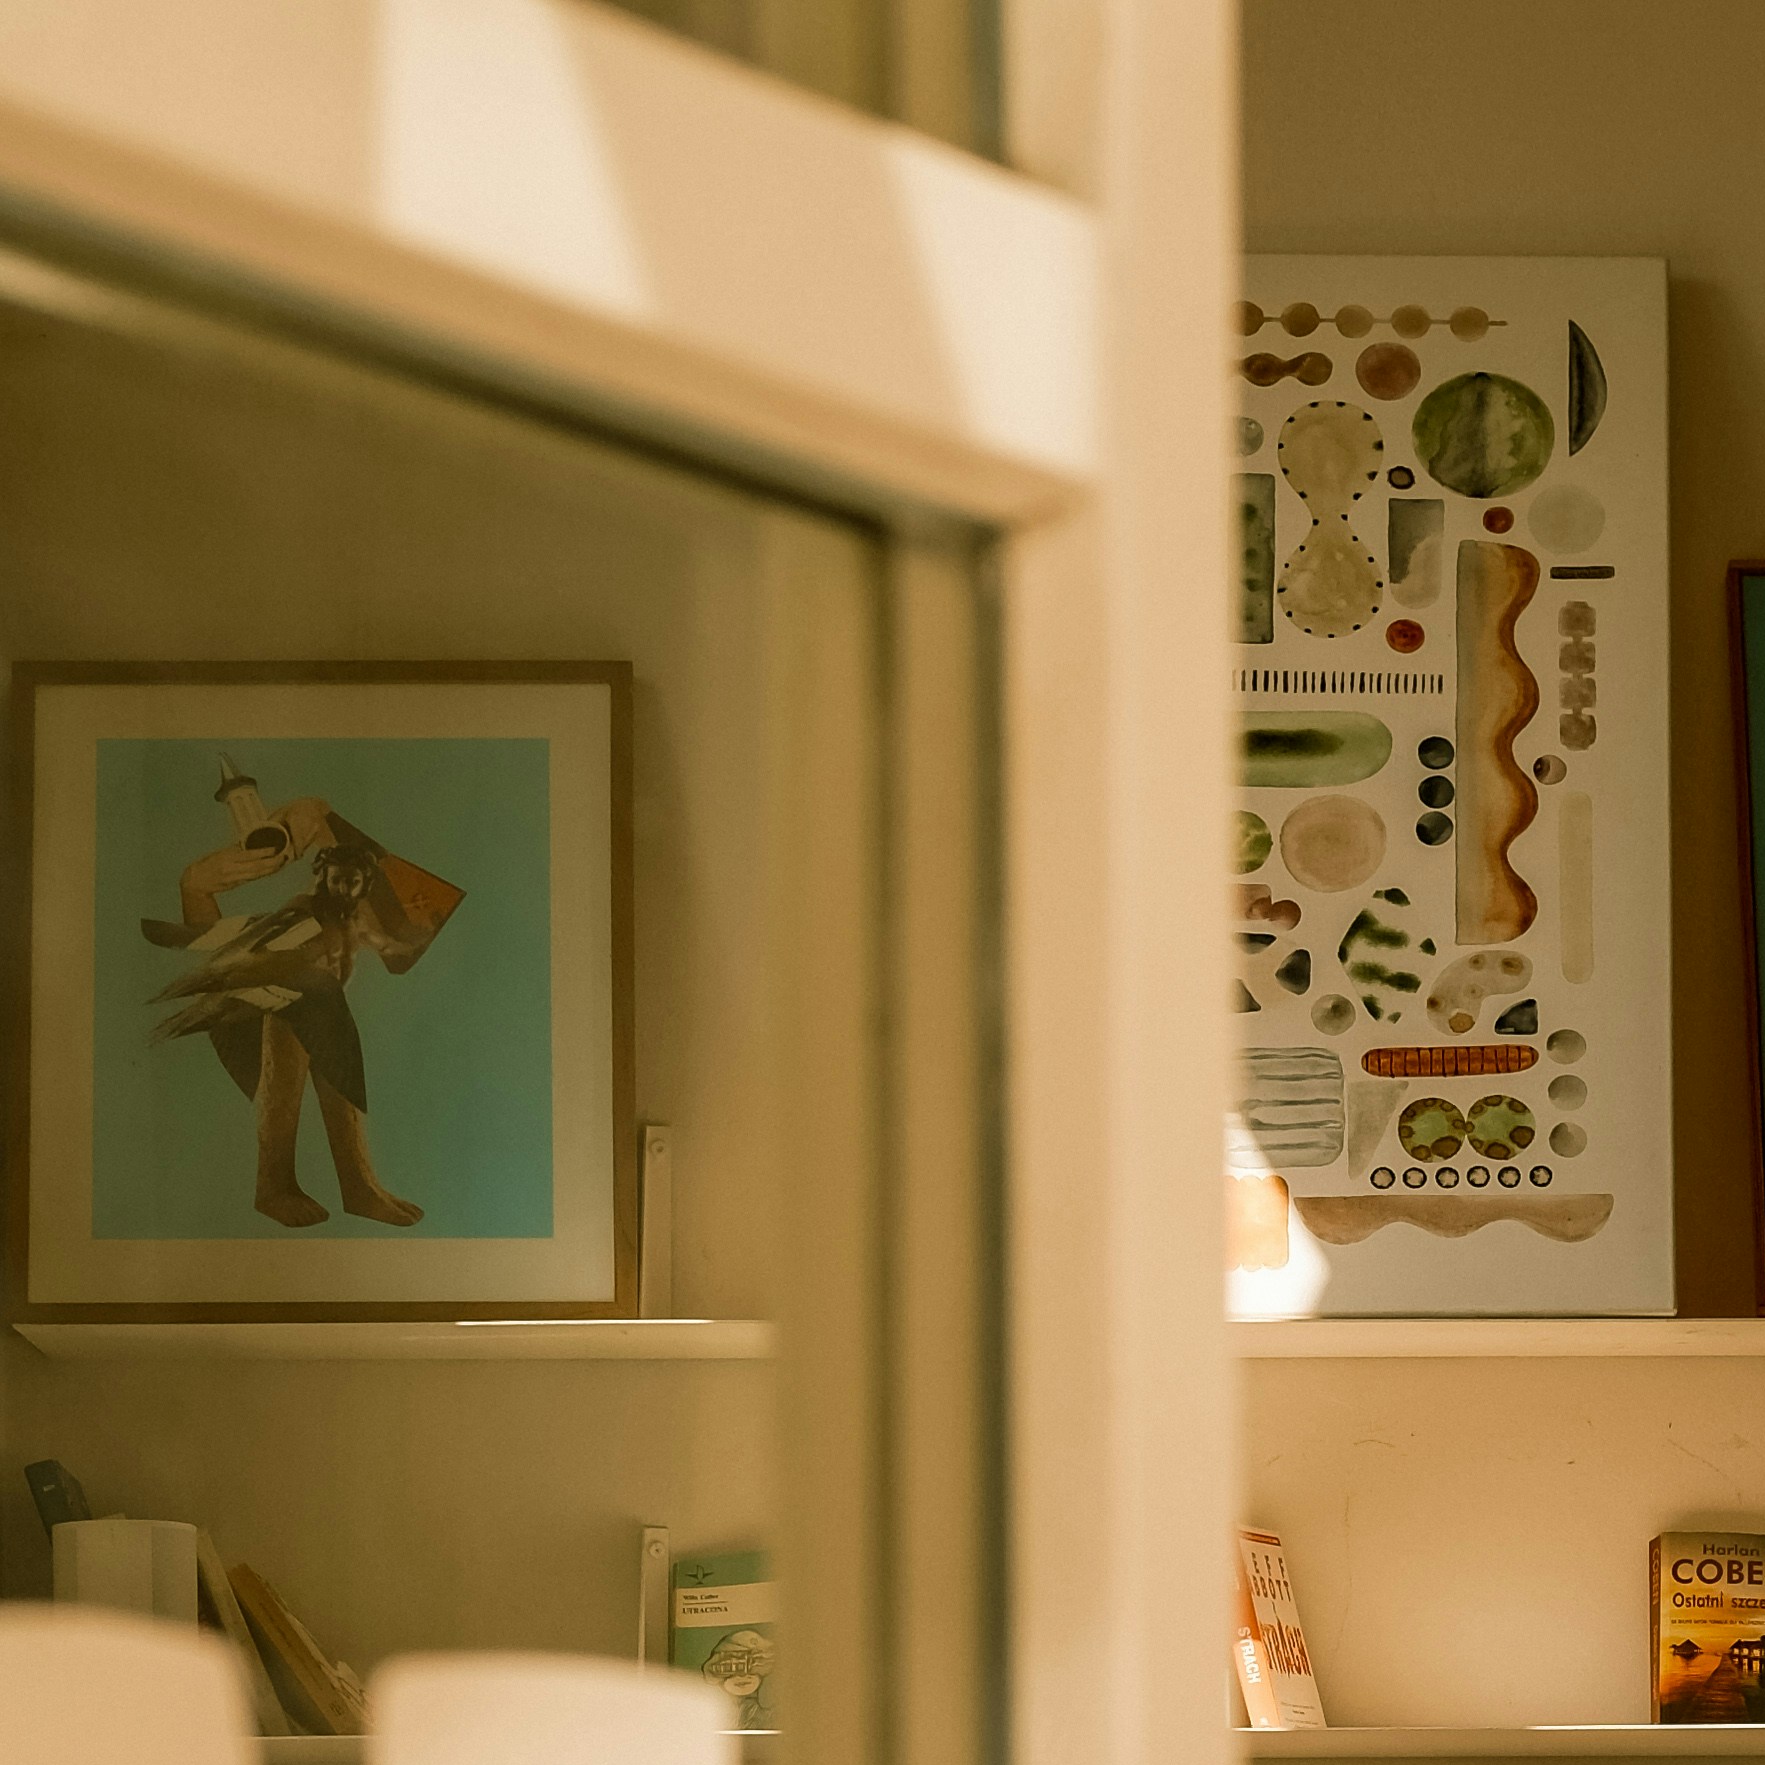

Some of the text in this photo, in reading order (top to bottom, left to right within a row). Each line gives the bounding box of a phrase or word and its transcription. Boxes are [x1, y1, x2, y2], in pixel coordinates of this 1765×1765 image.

[1702, 1543, 1760, 1557] Harlan
[1252, 1574, 1291, 1602] BBOTT
[1672, 1590, 1724, 1609] Ostatni
[1239, 1626, 1261, 1684] STRACH
